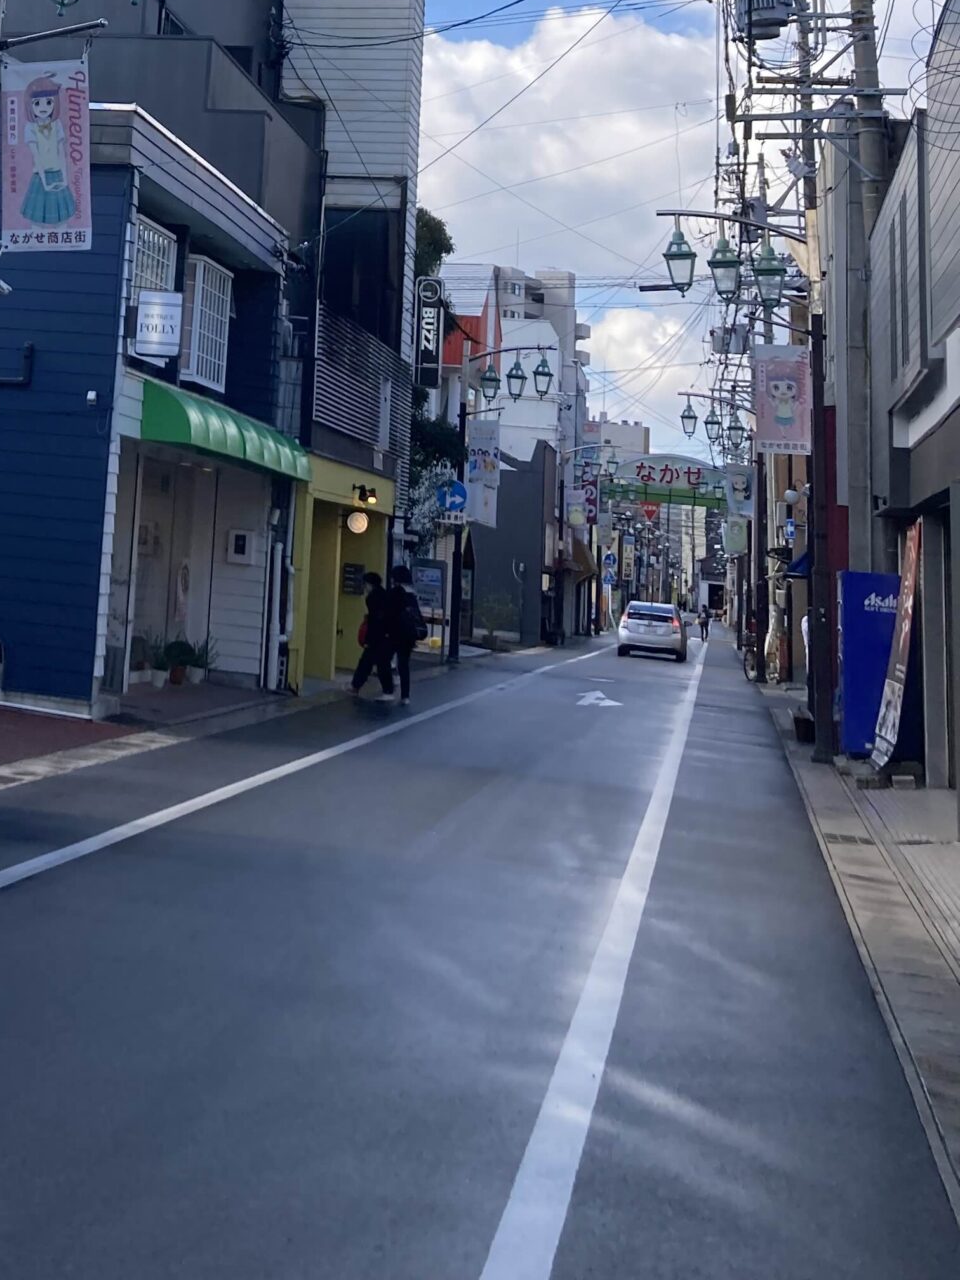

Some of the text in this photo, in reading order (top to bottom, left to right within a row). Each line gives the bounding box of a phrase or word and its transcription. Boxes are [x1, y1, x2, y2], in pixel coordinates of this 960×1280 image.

[9, 230, 86, 245] ながせ商店街
[139, 322, 178, 335] POLLY
[420, 307, 435, 351] BUZZ
[863, 592, 898, 608] Asah
